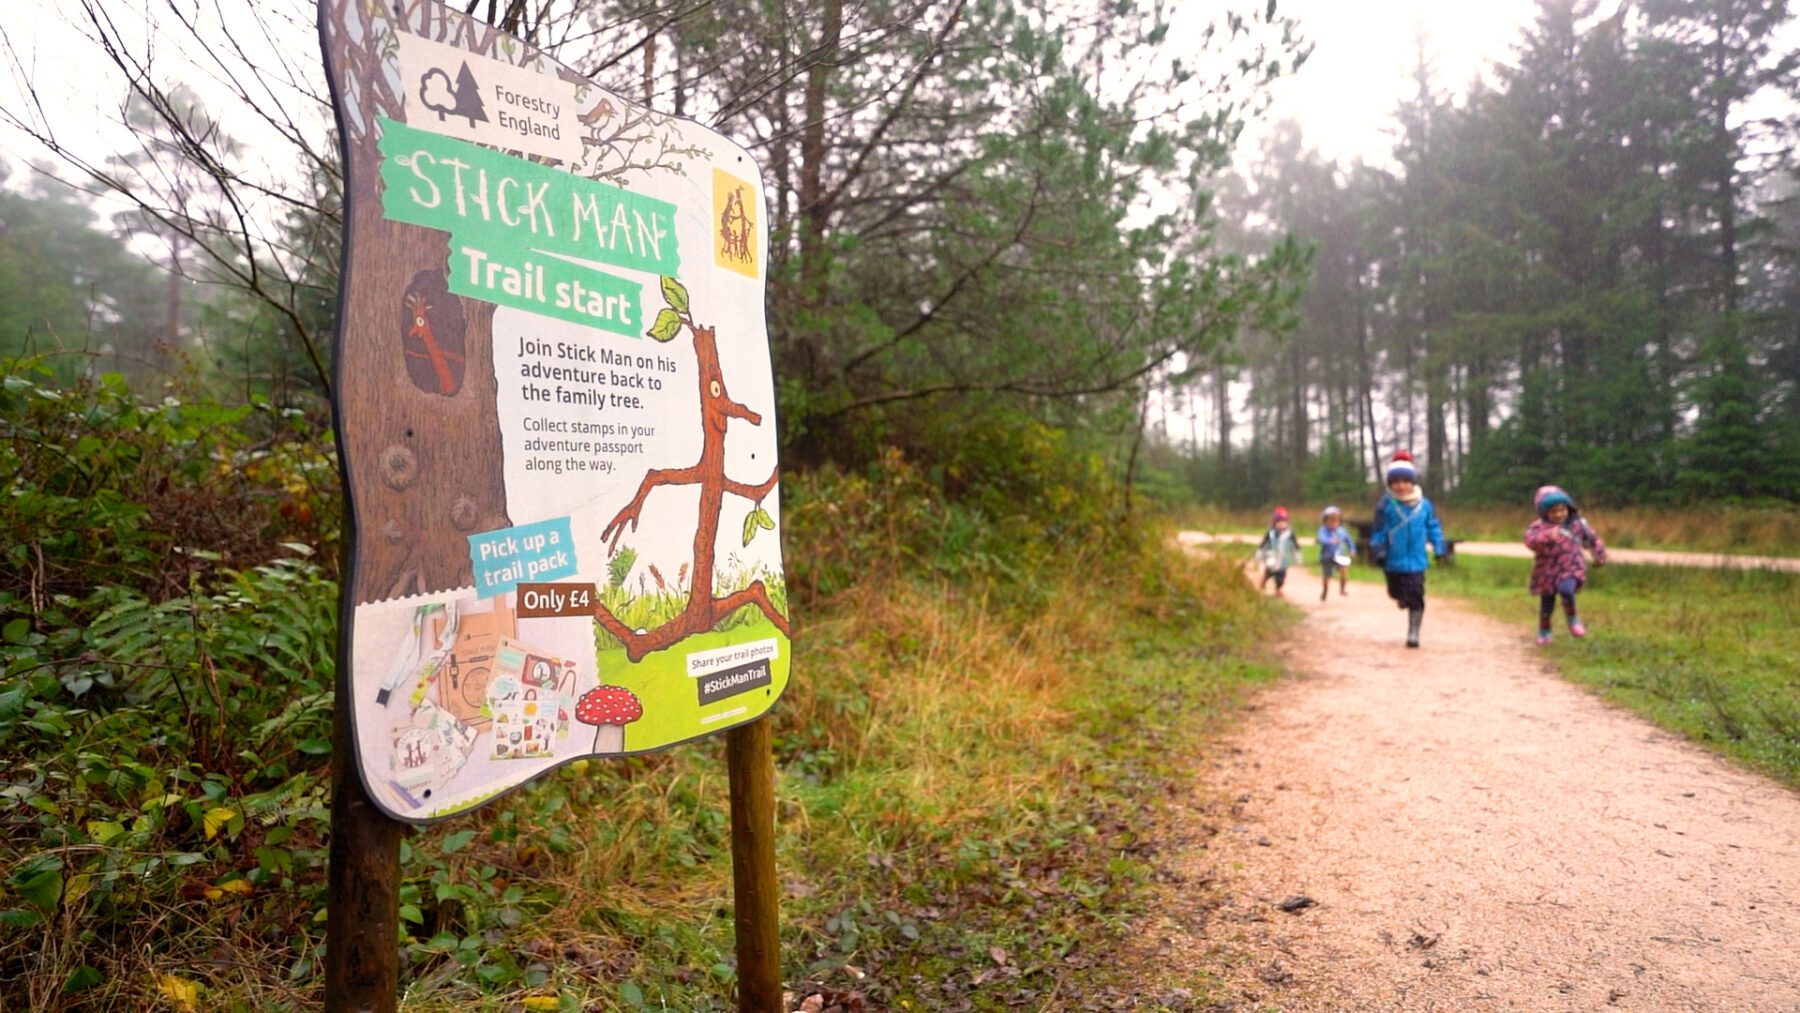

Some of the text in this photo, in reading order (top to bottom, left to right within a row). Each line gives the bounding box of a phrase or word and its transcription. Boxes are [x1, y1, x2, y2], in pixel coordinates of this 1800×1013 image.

[495, 84, 560, 120] Forestry
[499, 110, 560, 140] England
[394, 150, 668, 261] STICK MAN
[461, 247, 632, 325] Trail start
[518, 337, 677, 373] Join Stick Man on his
[521, 361, 662, 391] adventure back to
[521, 383, 644, 410] the family tree.
[523, 417, 656, 440] Collect stamps in your
[524, 437, 644, 456] adventure passport
[525, 457, 617, 475] along the way.
[480, 530, 560, 561] Pick up a
[484, 550, 568, 587] trail pack
[523, 588, 590, 612] Only £4
[692, 645, 774, 669] Share your trail photos
[703, 665, 767, 694] #StickManTrail
